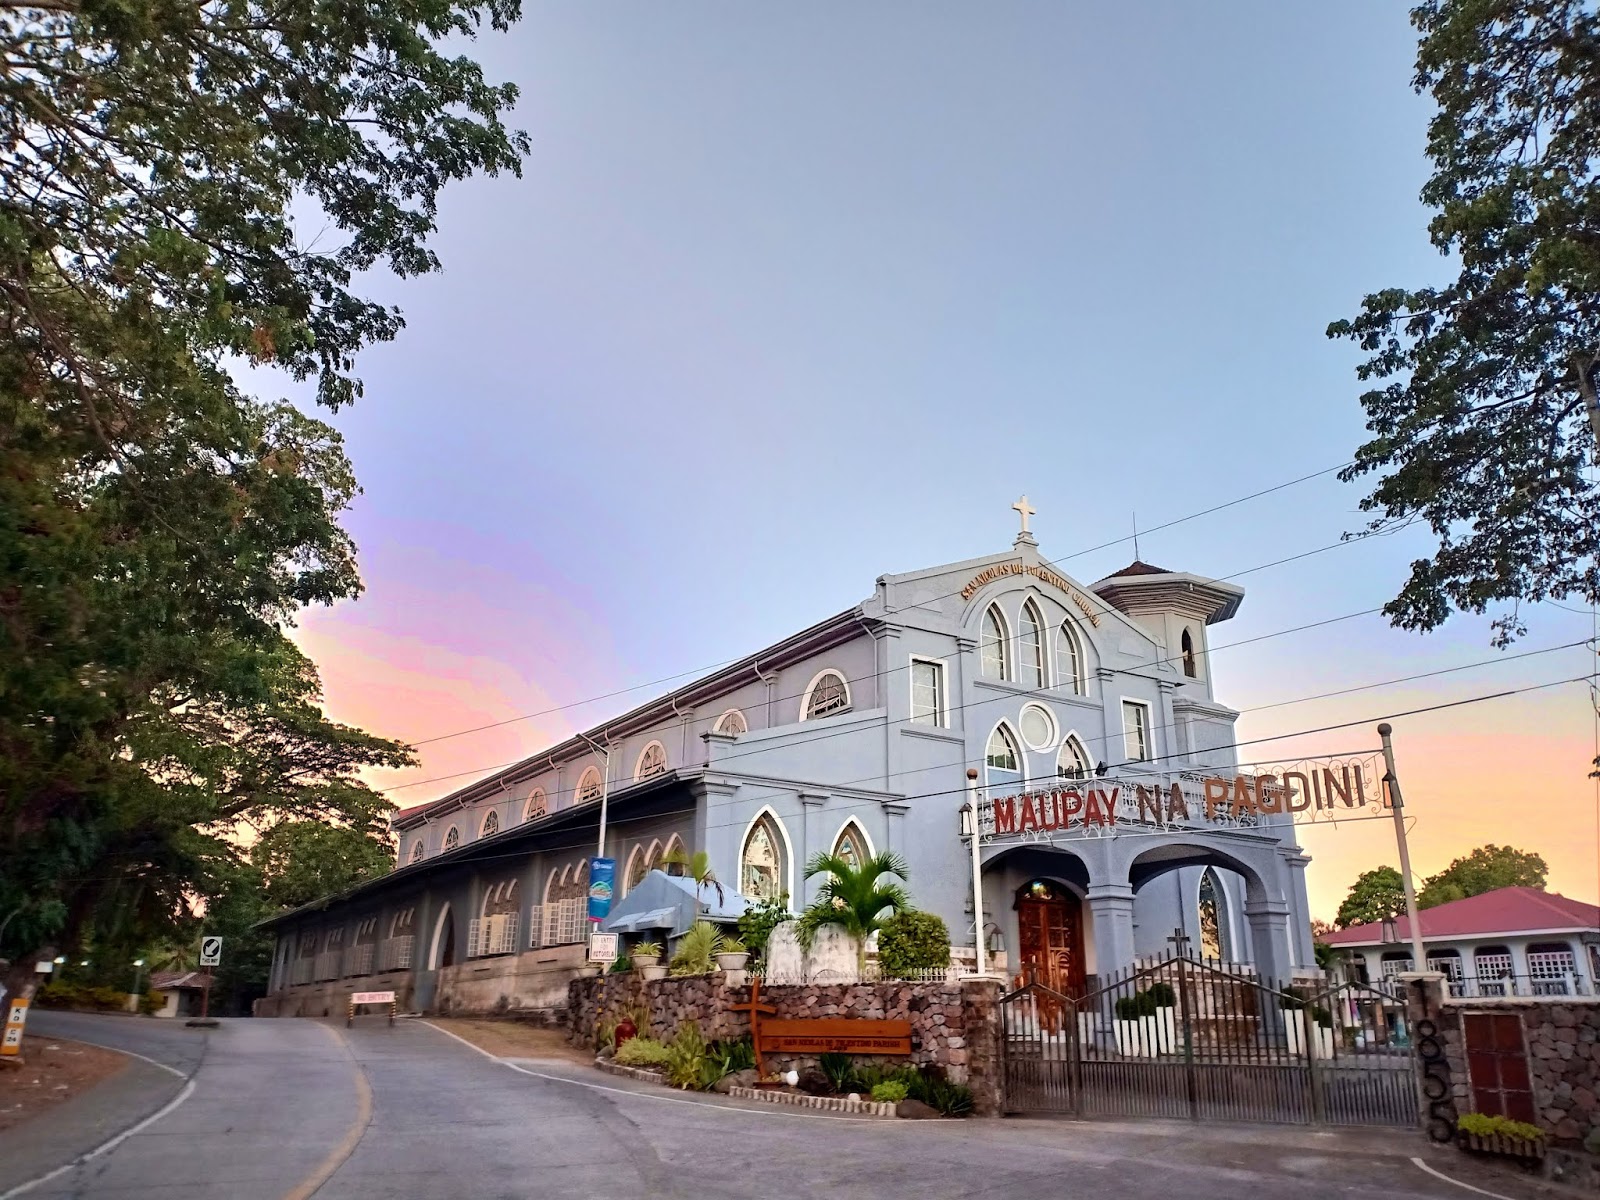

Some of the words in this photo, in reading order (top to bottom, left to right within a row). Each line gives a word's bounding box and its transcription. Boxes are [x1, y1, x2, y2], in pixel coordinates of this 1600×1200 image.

[961, 580, 976, 601] SAN
[975, 564, 1009, 584] NICOLAS
[1011, 563, 1023, 575] DE
[1072, 592, 1101, 628] CHURCH
[994, 787, 1120, 834] MAUPAY
[1135, 782, 1191, 825] NA
[1204, 764, 1366, 820] PAGDINI
[357, 994, 366, 1002] NO
[368, 993, 391, 1001] ENTRY
[872, 1040, 900, 1048] PARISH
